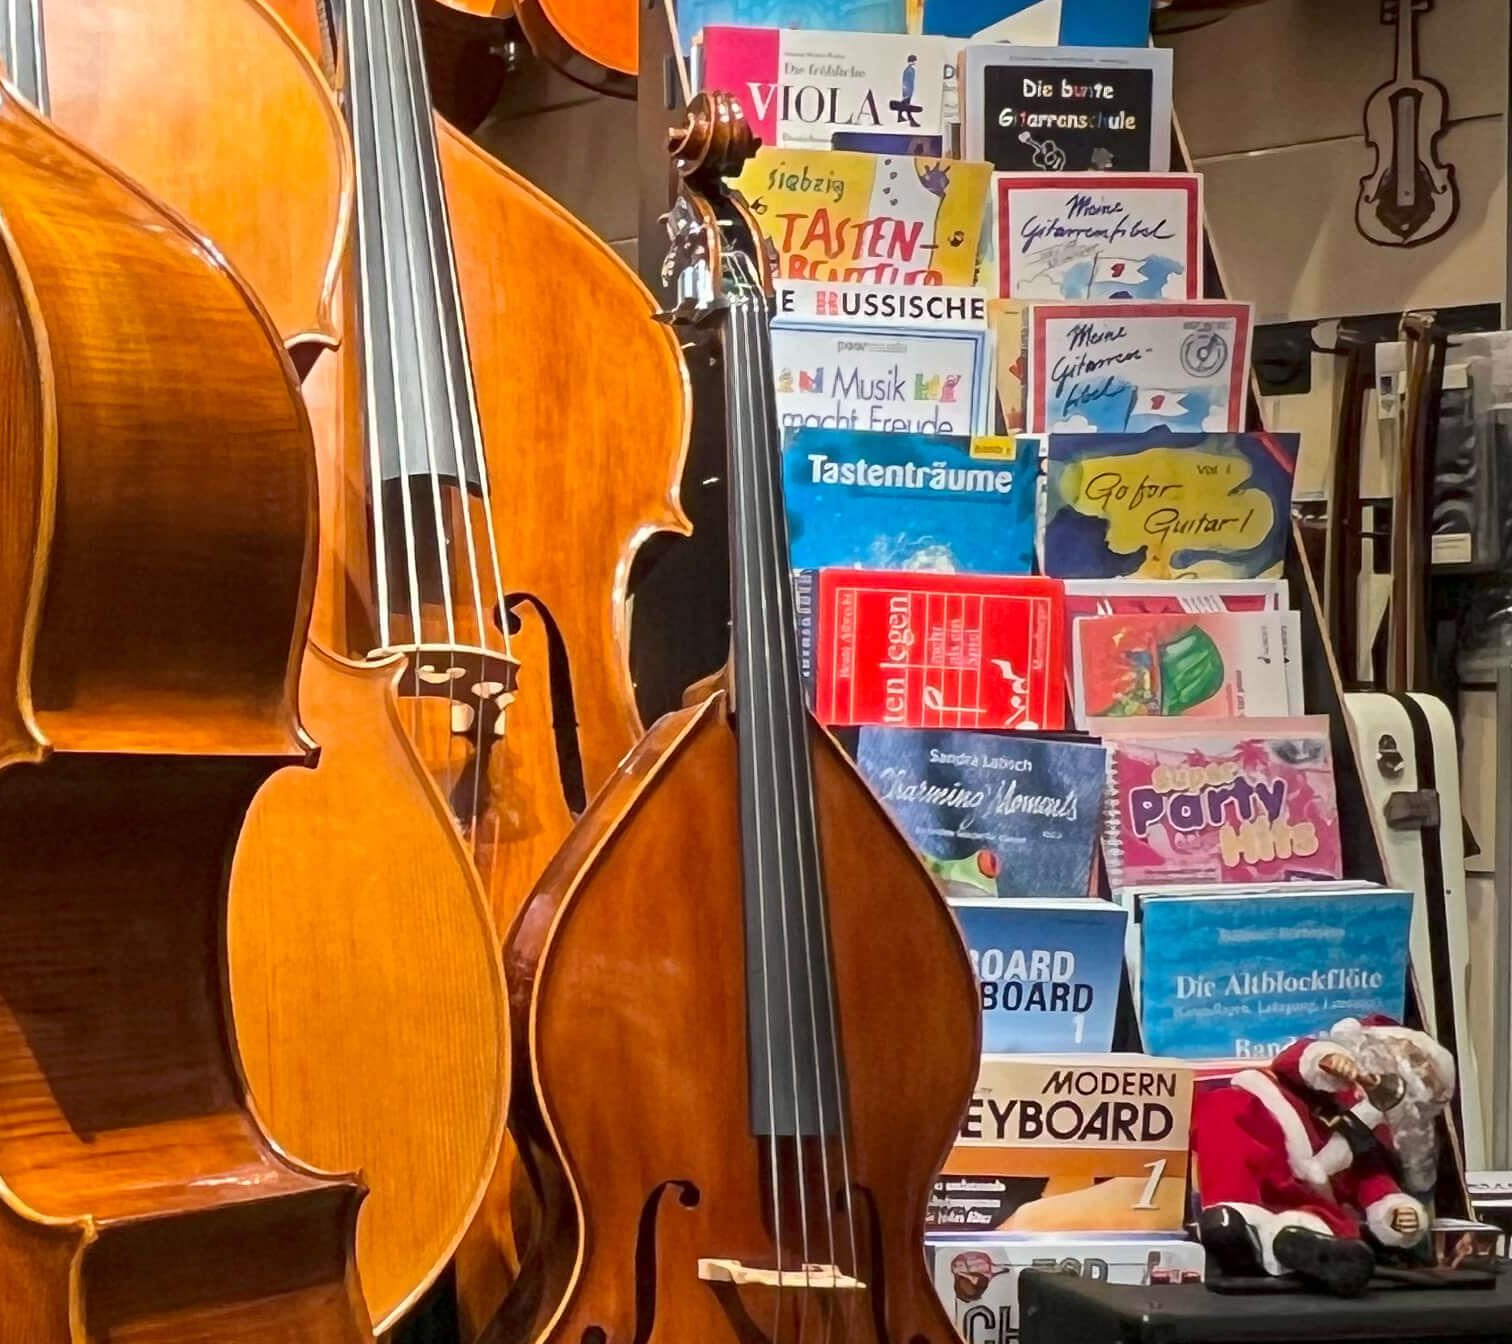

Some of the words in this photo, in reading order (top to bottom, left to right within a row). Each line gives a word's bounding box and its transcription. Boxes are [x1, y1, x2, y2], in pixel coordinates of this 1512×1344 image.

[746, 82, 884, 126] VIOLA
[1023, 79, 1053, 98] Die
[1061, 78, 1115, 99] bunte
[998, 108, 1137, 130] Gitarrenschule
[831, 364, 907, 402] Musik
[808, 454, 1013, 494] Tastenträume
[1085, 472, 1129, 512] Go
[1128, 474, 1183, 511] for
[1143, 508, 1238, 544] Guitar
[883, 677, 906, 723] ten
[929, 749, 978, 767] Sandra
[1129, 776, 1287, 838] Party
[1176, 974, 1216, 999] Die
[1224, 967, 1384, 997] Altblockflöte
[1072, 1013, 1085, 1044] 1
[1042, 1070, 1176, 1097] MODERN
[960, 1099, 1174, 1142] EYBOARD
[1131, 1158, 1167, 1210] 1
